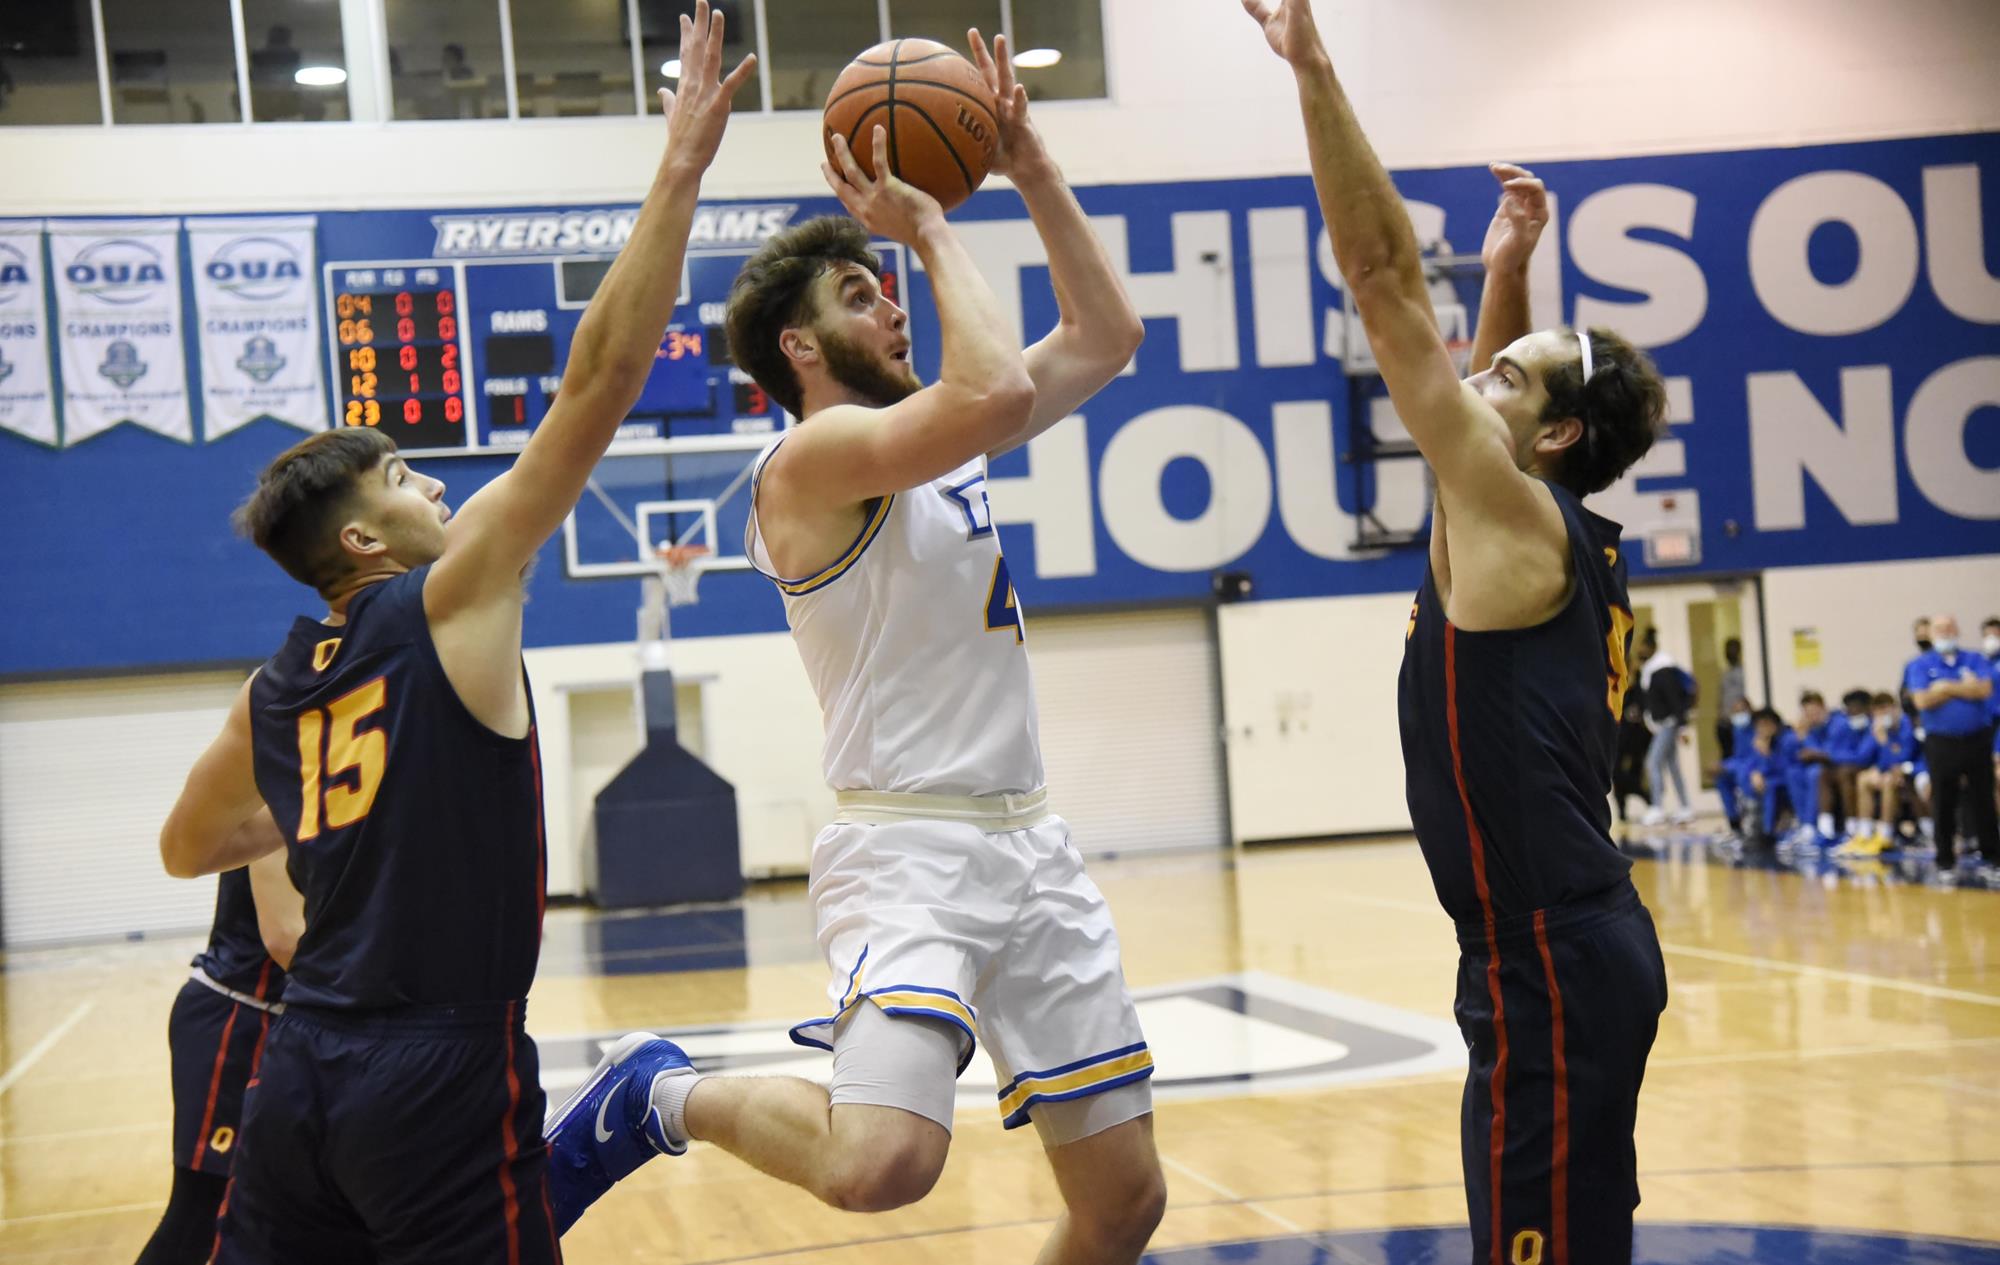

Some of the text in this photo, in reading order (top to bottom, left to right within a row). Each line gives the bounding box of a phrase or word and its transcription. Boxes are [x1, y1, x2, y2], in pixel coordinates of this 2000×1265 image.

[443, 209, 783, 250] RYERSON AMS
[66, 264, 165, 284] OUA
[206, 260, 302, 281] OUA
[910, 198, 1458, 376] THIS
[1497, 183, 1708, 348] IS
[337, 290, 453, 319] 04 0 0
[67, 322, 172, 339] CHAMPIONS
[207, 317, 309, 335] CHAMPIONS
[339, 316, 456, 345] 06 0 0
[491, 309, 548, 333] RAMS
[400, 345, 417, 371] 0
[441, 343, 457, 370] 2
[351, 368, 460, 398] 12 1 0
[345, 396, 462, 427] 23 0 0
[513, 395, 525, 423] 1
[987, 376, 1700, 580] HOUE
[983, 553, 1025, 646] 4
[296, 675, 385, 843] 15
